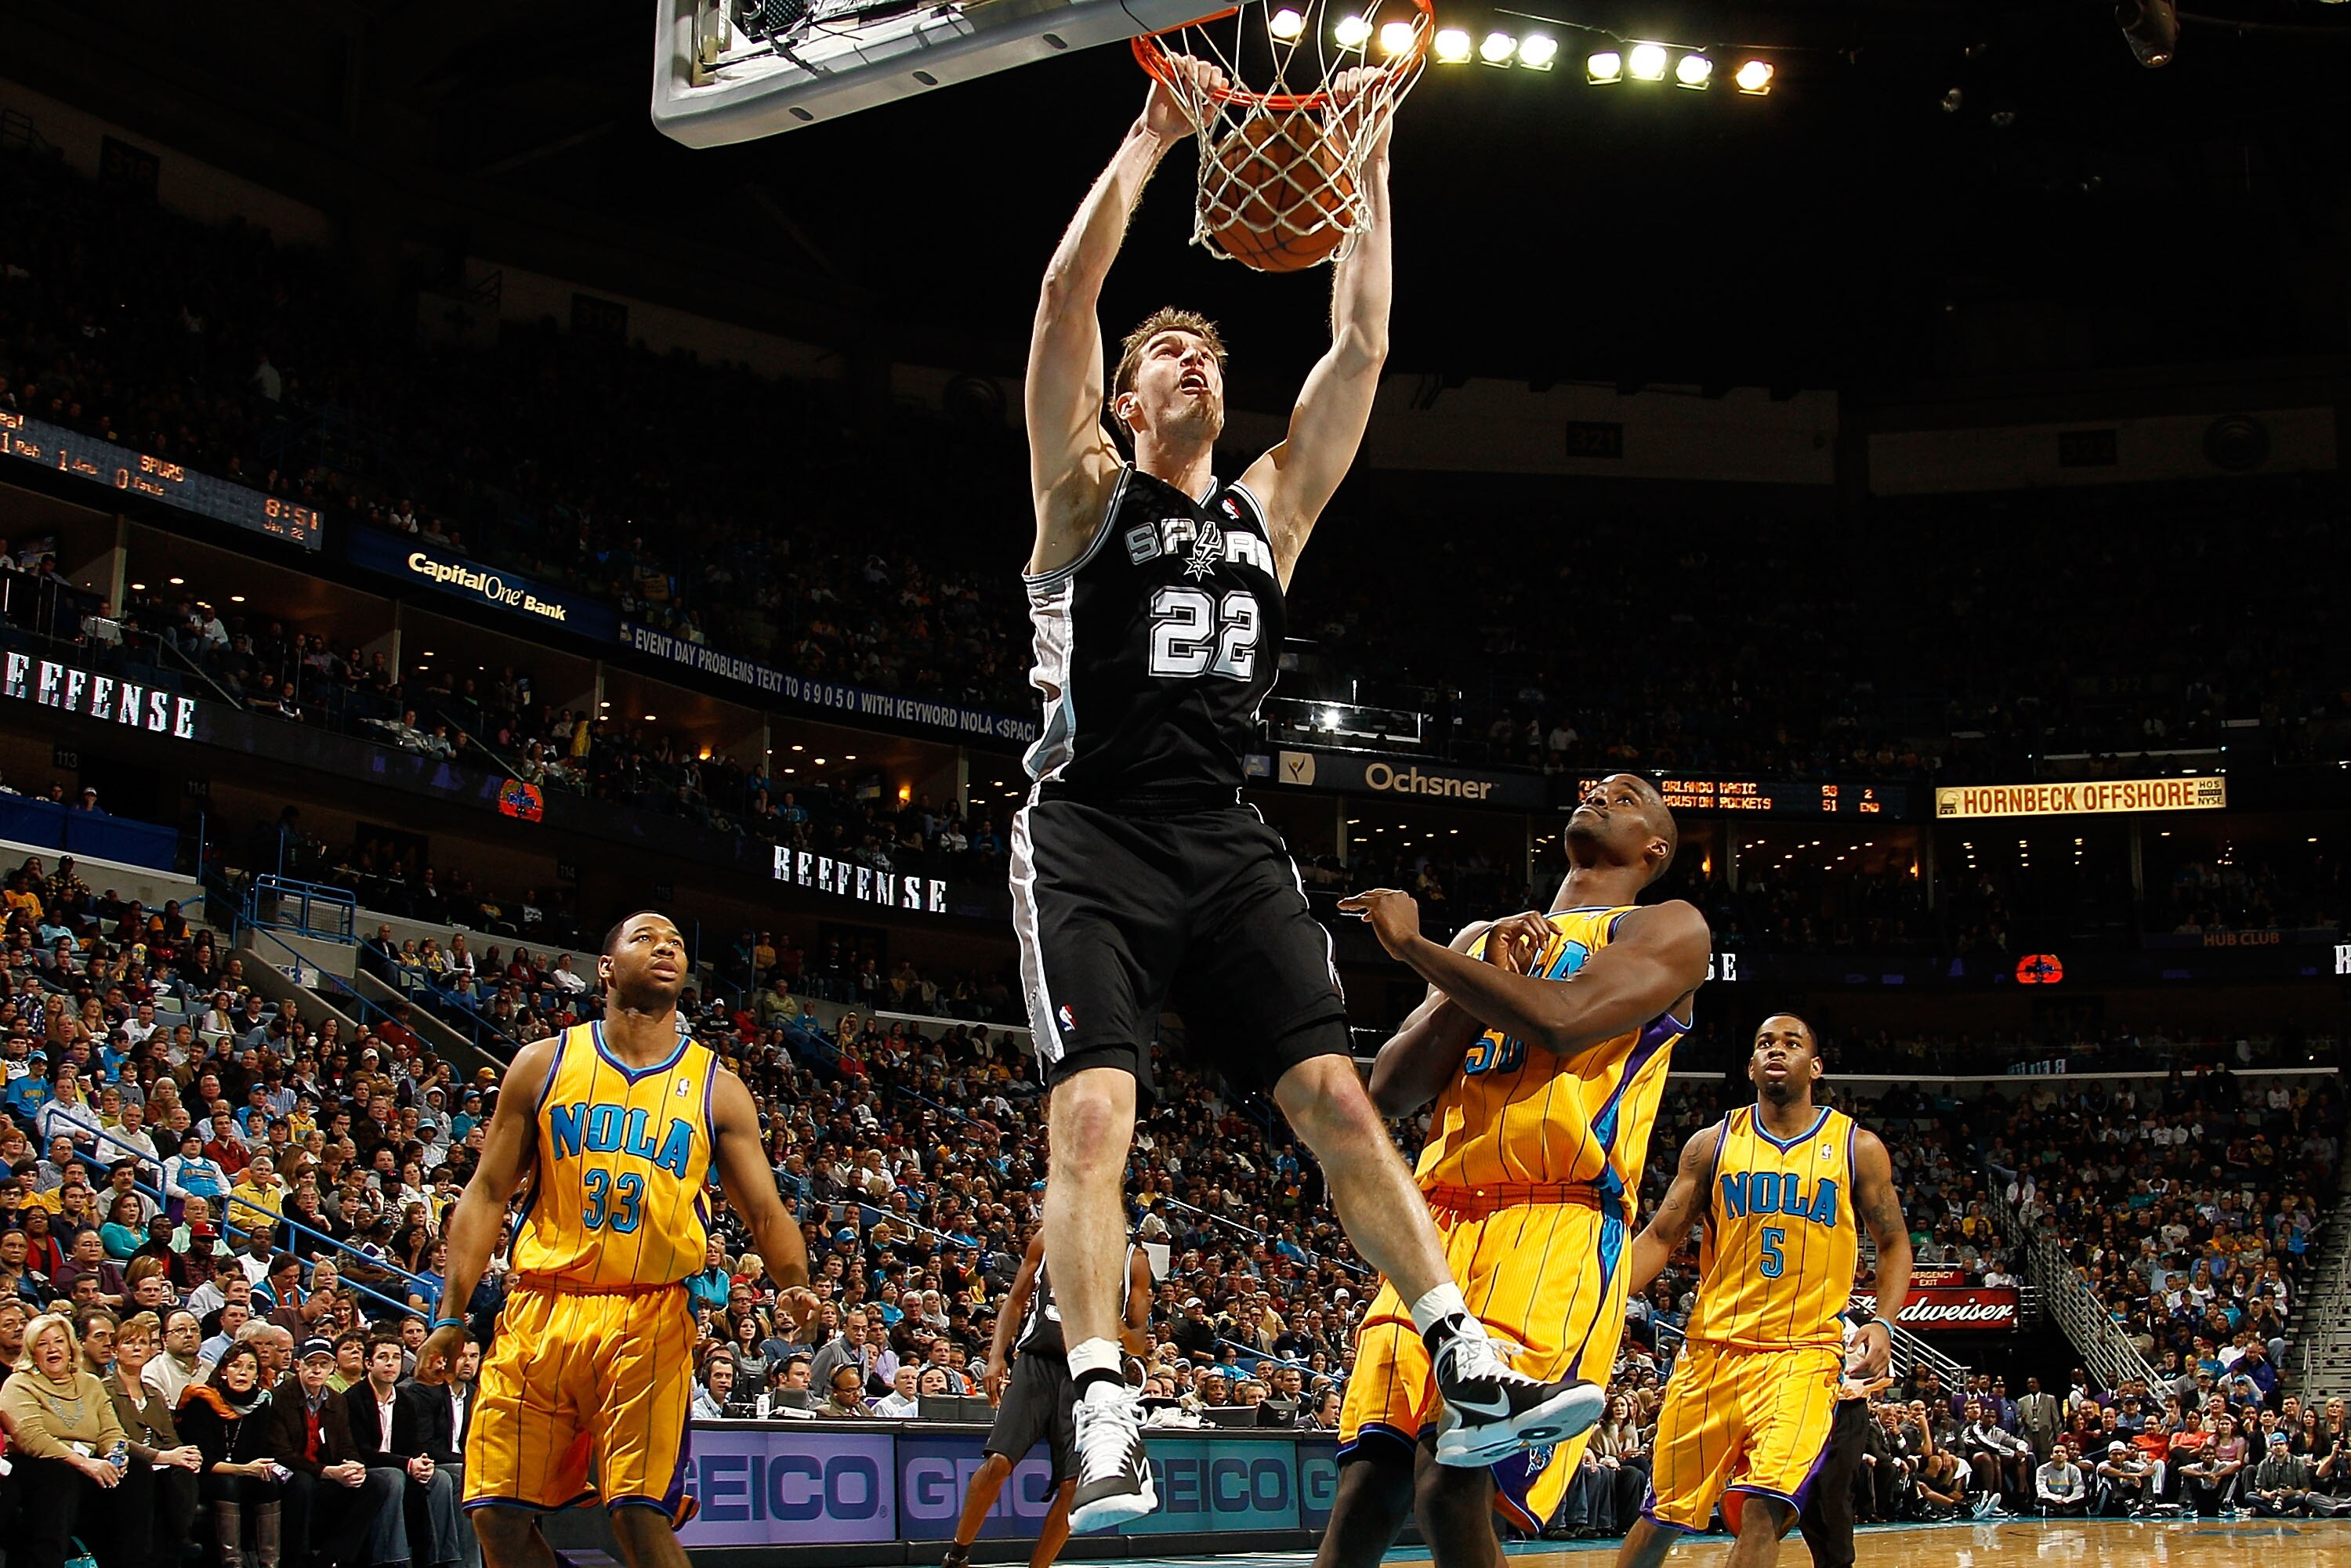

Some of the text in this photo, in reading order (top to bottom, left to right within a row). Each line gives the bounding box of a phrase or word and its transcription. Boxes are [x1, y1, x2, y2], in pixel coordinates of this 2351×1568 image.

[140, 454, 185, 483] SPURS
[523, 595, 567, 621] Bank
[1149, 586, 1260, 682] 22
[635, 628, 672, 658] EVENT
[674, 639, 697, 666] DAY
[697, 647, 754, 684] PROBLEMS
[756, 666, 783, 693] TEXT
[785, 675, 799, 697] TO
[861, 692, 893, 717] WITH
[896, 699, 958, 728] KEYWORD
[960, 711, 993, 735] NOLA
[996, 719, 1035, 742] <SPAC
[1365, 762, 1492, 800] Ochsner
[1661, 780, 1714, 794] ORLANDO
[2199, 780, 2220, 788] HOS
[1662, 795, 1714, 808] HOUSTON
[1719, 796, 1771, 809] ROCKETS
[1822, 799, 1837, 812] 51
[1964, 782, 2195, 814] HORNBECK OFFSHORE
[2198, 796, 2224, 806] NYSE
[2204, 931, 2280, 947] HUB CLUB
[550, 1102, 696, 1180] NOLA
[582, 1168, 645, 1234] 33
[1720, 1171, 1838, 1228] NOLA
[1759, 1227, 1785, 1279] 5
[1849, 1295, 2014, 1322] dweiser
